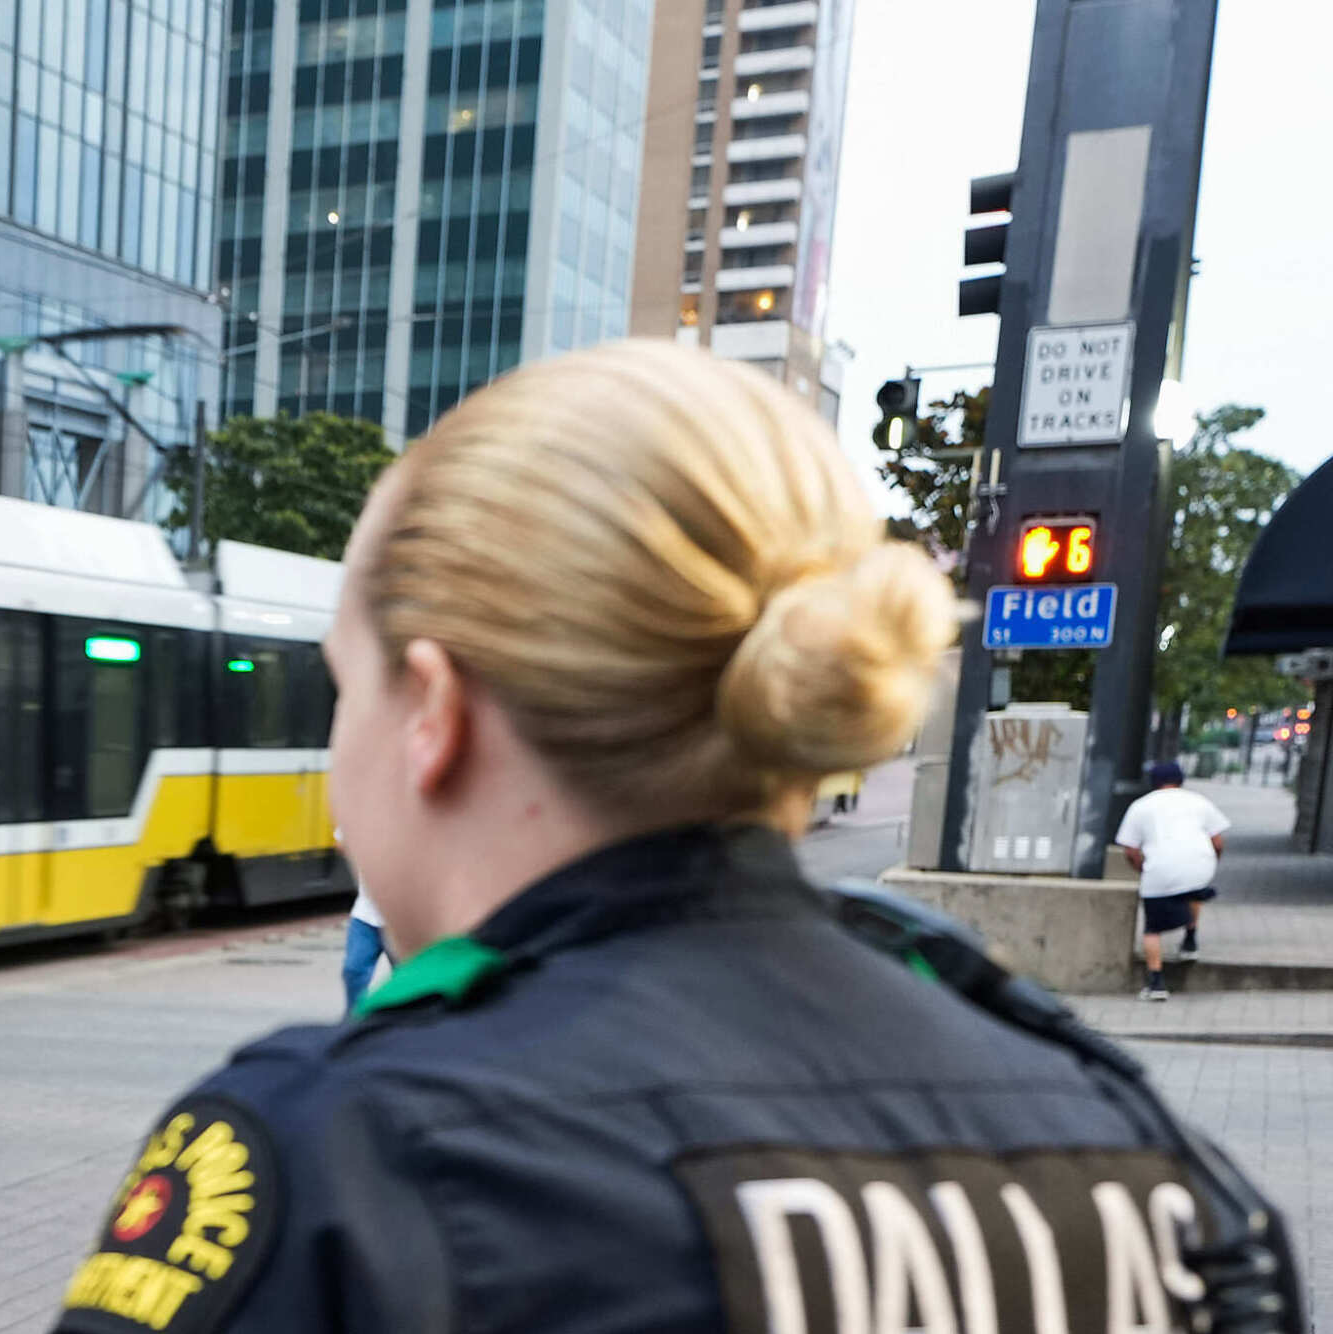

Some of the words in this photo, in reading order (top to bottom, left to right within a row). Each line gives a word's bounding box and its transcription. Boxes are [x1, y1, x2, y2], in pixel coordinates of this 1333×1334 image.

[1038, 341, 1066, 360] DO
[1079, 338, 1120, 356] NOT
[1040, 363, 1111, 384] DRIVE
[1058, 389, 1092, 407] ON
[1030, 410, 1115, 431] TRACKS
[1067, 527, 1092, 573] 6
[1002, 589, 1099, 619] Field
[174, 1119, 256, 1282] POLICE
